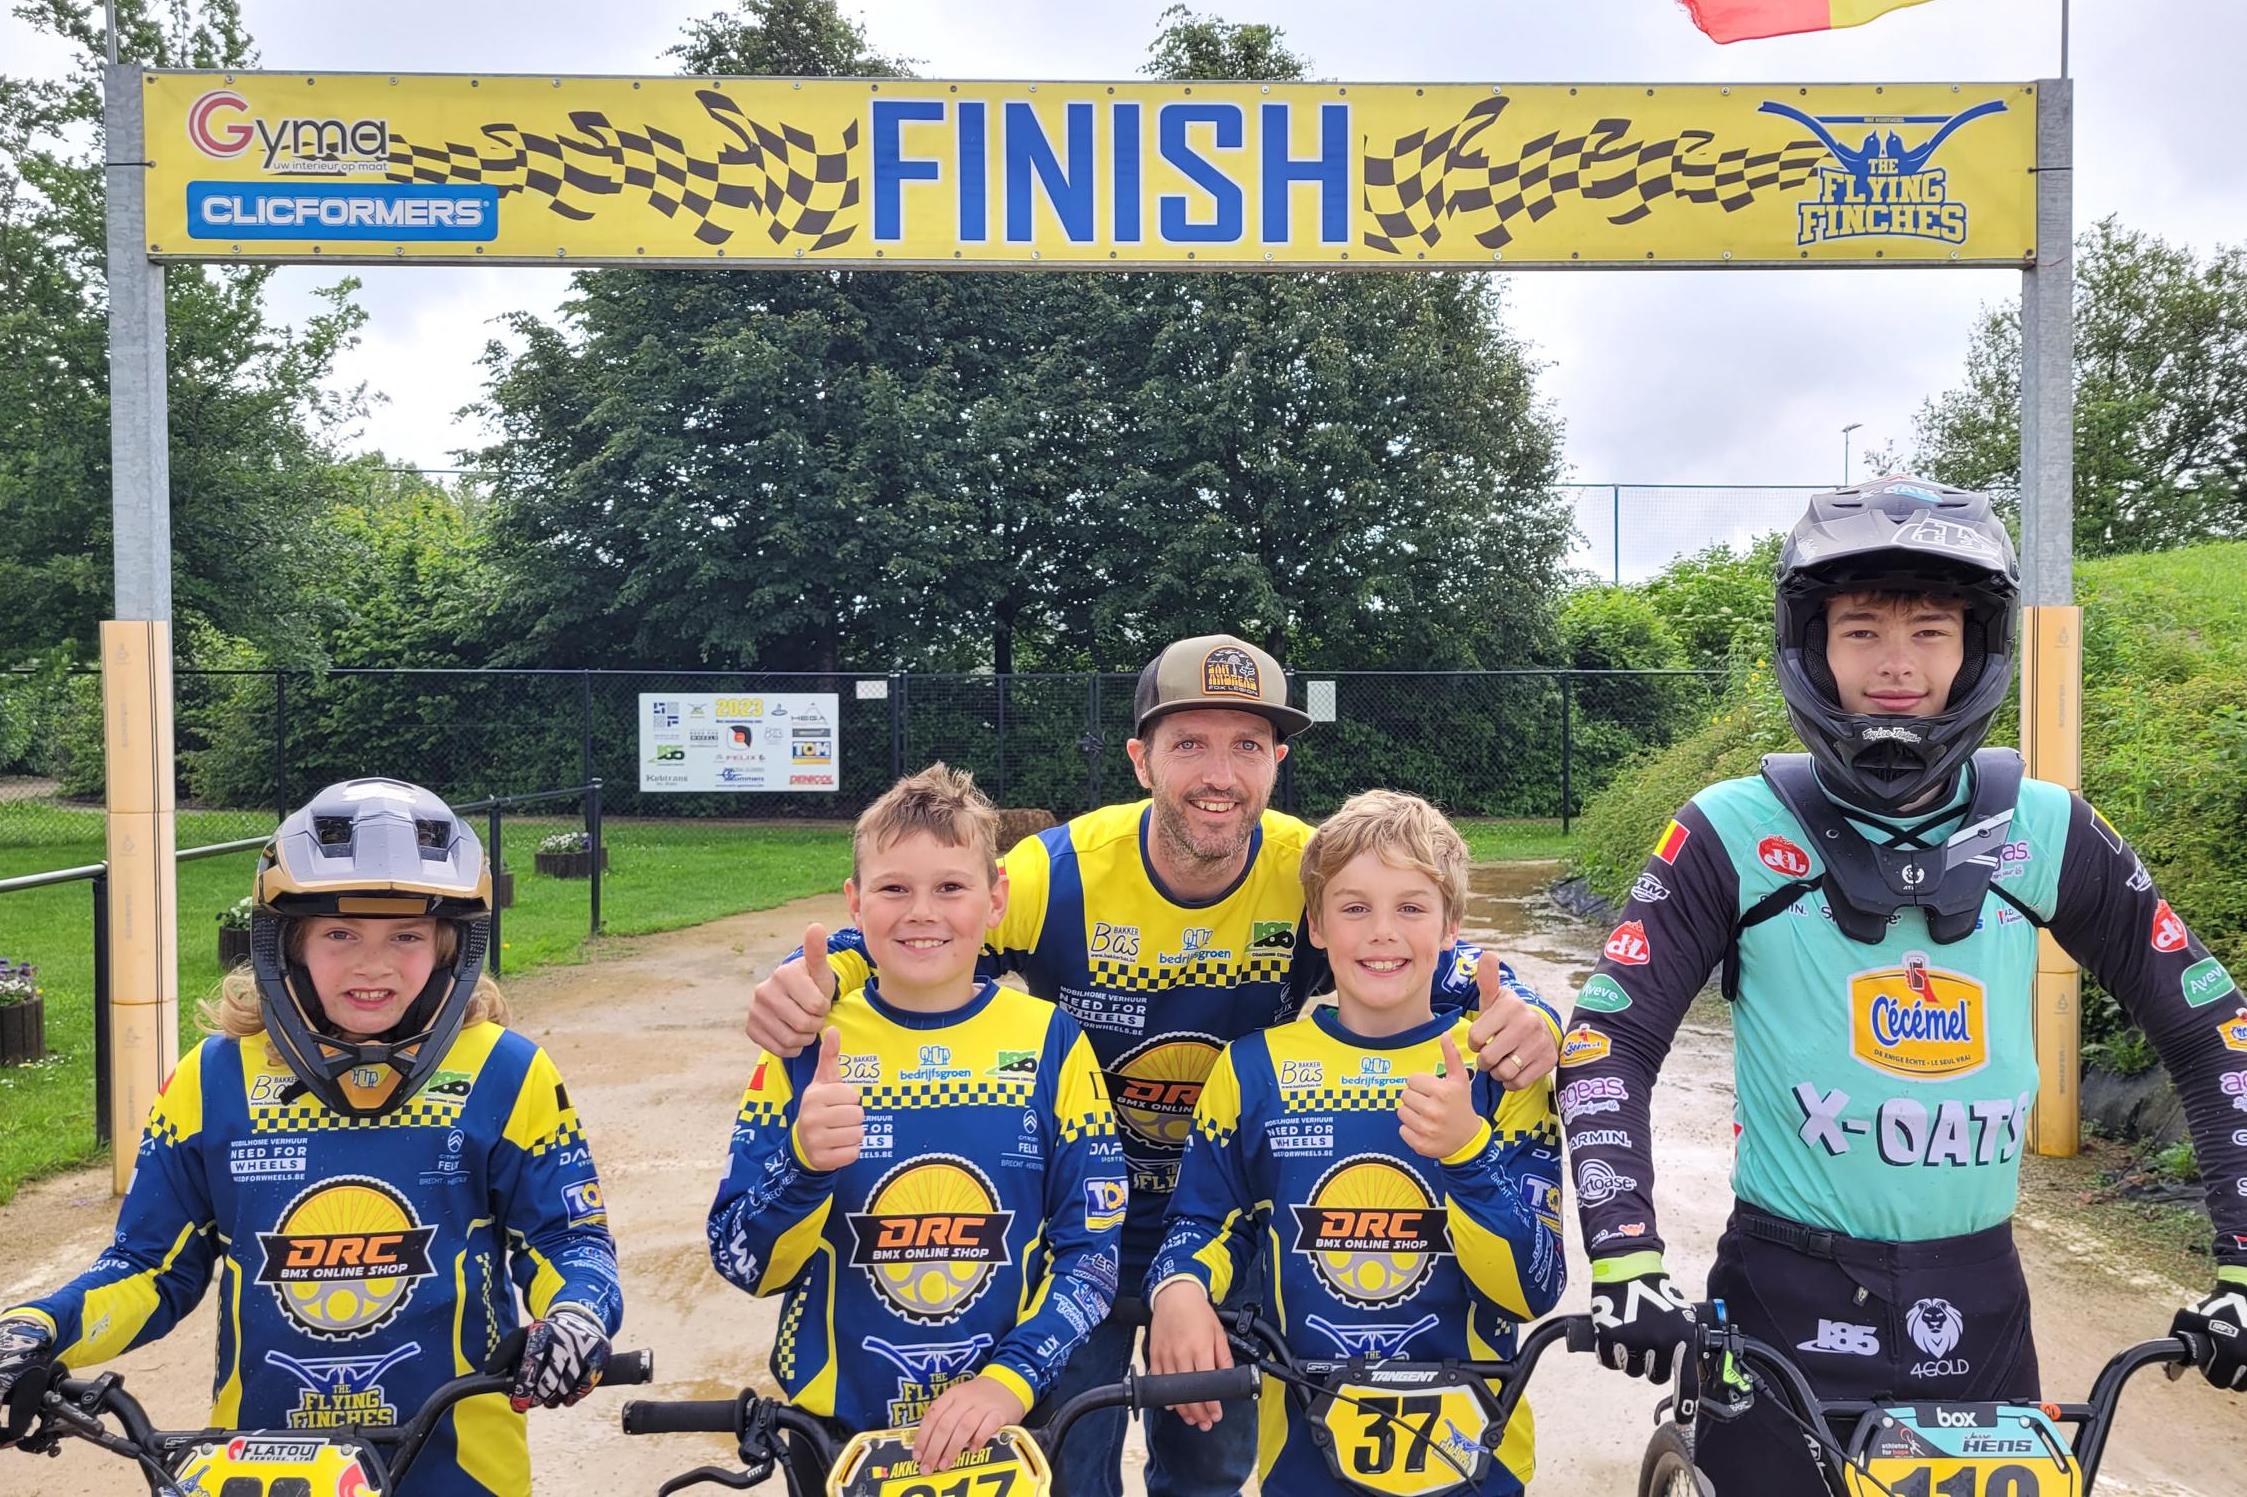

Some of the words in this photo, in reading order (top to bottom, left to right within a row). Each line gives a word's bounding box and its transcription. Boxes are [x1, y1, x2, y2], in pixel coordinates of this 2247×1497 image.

[189, 91, 387, 169] Gyma
[273, 162, 289, 170] uw
[292, 160, 339, 171] interieur
[341, 163, 356, 173] op
[359, 162, 388, 171] maat
[873, 101, 1349, 242] FINISH
[1868, 158, 1899, 174] THE
[1820, 169, 1946, 202] FLYING
[202, 196, 482, 227] CLICFORMERS
[1798, 203, 1967, 245] FINCHES
[715, 698, 764, 717] 2023
[1091, 922, 1139, 956] Bas
[1113, 926, 1139, 936] BAKKER
[1059, 993, 1103, 1011] NEED
[1112, 1003, 1147, 1015] FOR
[1109, 994, 1148, 1004] VERHUUR
[1066, 1006, 1138, 1026] WHEELS
[1871, 995, 1971, 1047] Cécémel
[853, 1055, 878, 1064] BAKKER
[900, 1068, 971, 1083] bedrijfsgroen
[1281, 1060, 1323, 1084] Bas
[1122, 1080, 1200, 1105] DR
[1117, 1096, 1147, 1109] BMX
[1151, 1103, 1193, 1114] ONLIN
[1301, 1116, 1334, 1124] VERHUUR
[1267, 1126, 1299, 1136] NEED
[1305, 1125, 1334, 1134] FOR
[1275, 1137, 1327, 1147] WHEELS
[230, 1147, 266, 1159] NEED
[274, 1146, 307, 1157] FOR
[235, 1160, 298, 1172] WHEELS
[877, 1217, 986, 1248] DRC
[1320, 1211, 1424, 1239] DRC
[286, 1235, 404, 1267] DRC
[872, 1248, 901, 1260] BMX
[905, 1247, 949, 1259] ONLINE
[951, 1247, 990, 1258] SHOP
[1316, 1238, 1342, 1249] BMX
[1345, 1239, 1390, 1249] ONLINE
[1393, 1240, 1428, 1250] SHOP
[280, 1268, 309, 1278] BMX
[313, 1266, 365, 1277] ONLINE
[369, 1263, 408, 1275] SHOP
[1364, 1350, 1382, 1359] THE
[929, 1371, 949, 1381] THE
[1370, 1371, 1439, 1382] TANGENT
[1909, 1359, 1970, 1379] 4GOLD
[332, 1384, 352, 1394] THE
[303, 1389, 381, 1411] FLYING
[291, 1407, 394, 1429] FINCHES
[1936, 1406, 1979, 1428] box
[1353, 1394, 1443, 1475] 37
